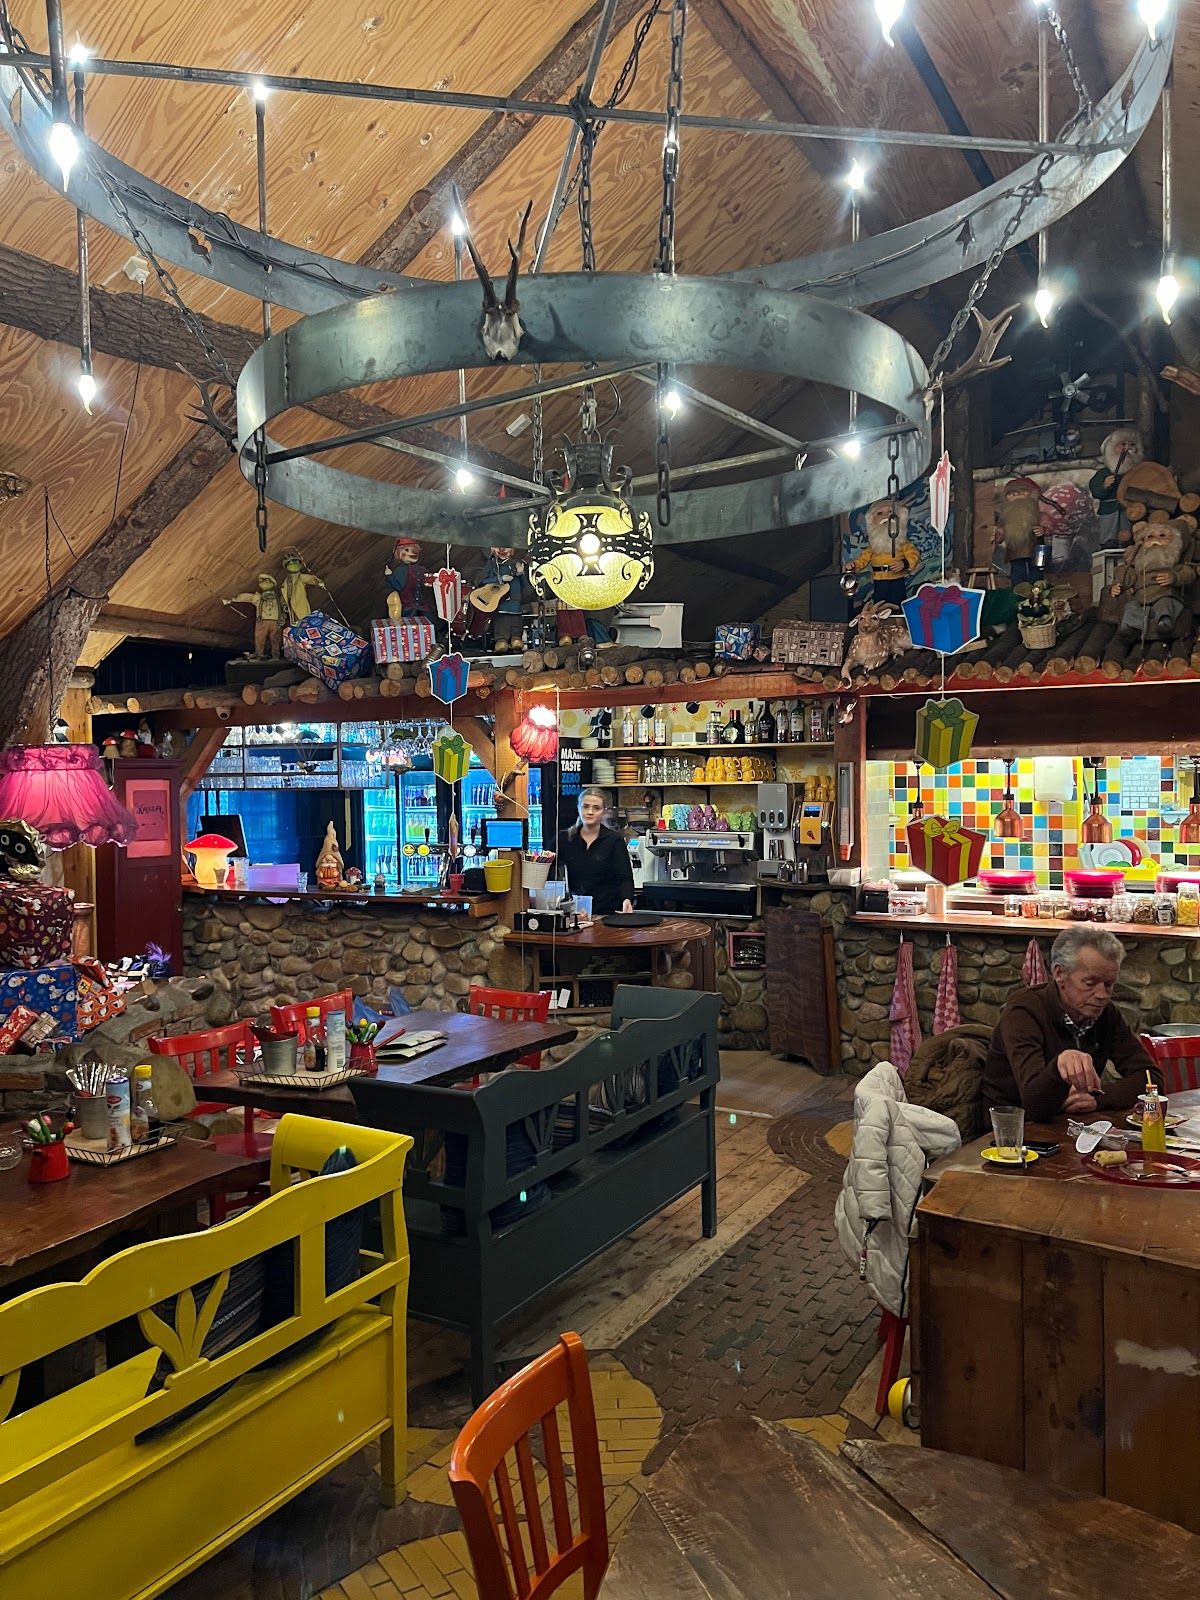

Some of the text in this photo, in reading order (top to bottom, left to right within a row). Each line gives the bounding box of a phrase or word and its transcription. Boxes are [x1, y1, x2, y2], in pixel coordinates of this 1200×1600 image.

[561, 748, 591, 760] MAXI
[560, 760, 581, 772] TASTE
[561, 772, 580, 784] ZERO
[561, 784, 583, 796] SUGA
